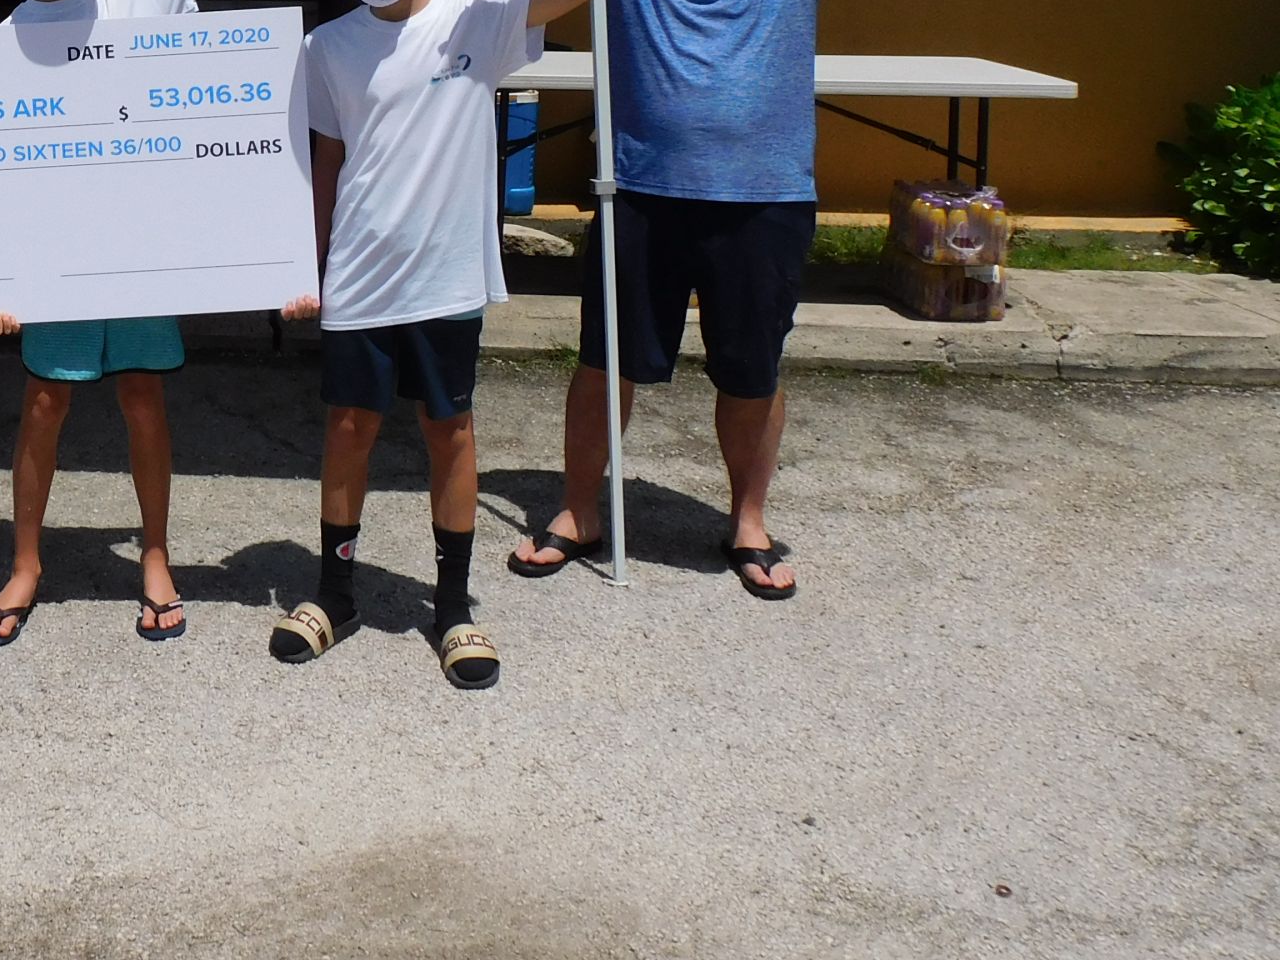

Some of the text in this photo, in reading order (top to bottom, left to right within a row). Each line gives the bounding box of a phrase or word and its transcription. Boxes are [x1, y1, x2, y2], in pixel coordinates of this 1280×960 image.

[67, 27, 270, 62] DATE JUNE 17, 2020
[13, 96, 67, 119] ARK
[118, 82, 272, 122] $ 53,016.36
[13, 140, 104, 162] SIXTEEN
[110, 136, 182, 156] 36/100
[195, 138, 283, 159] DOLLARS
[287, 609, 323, 636] UCCI
[447, 633, 496, 653] GUCC
